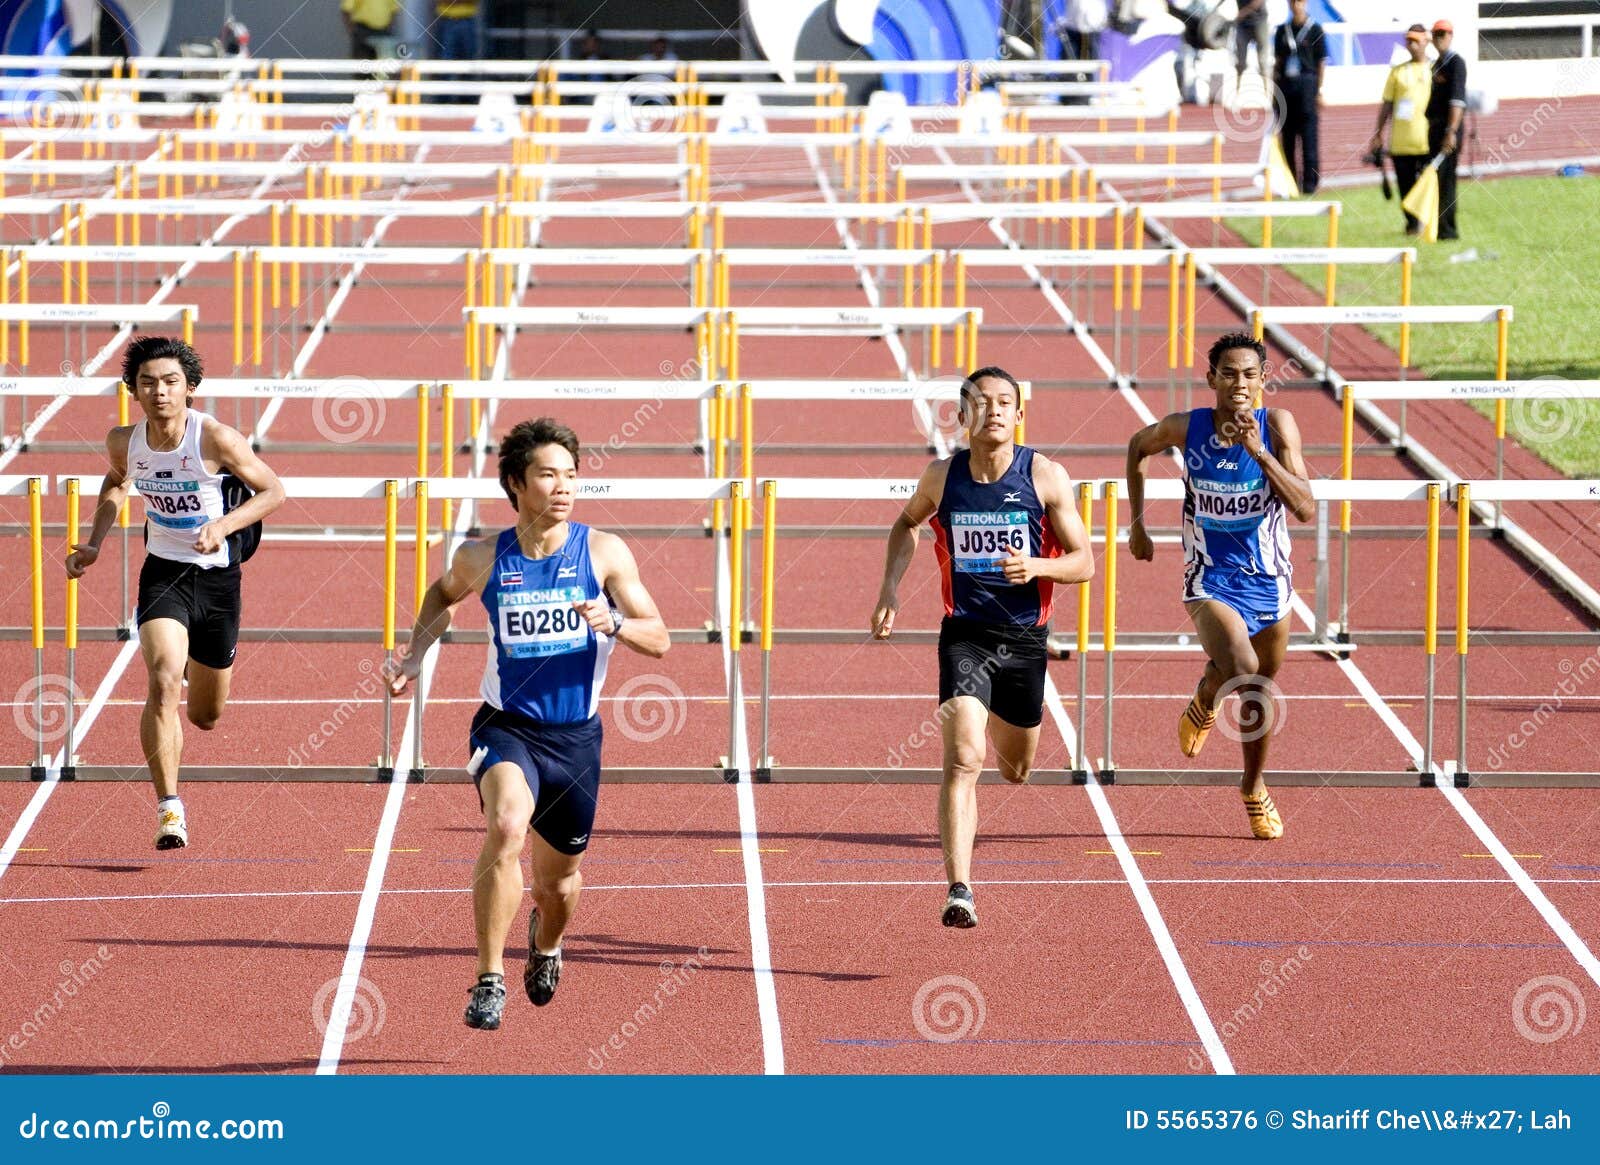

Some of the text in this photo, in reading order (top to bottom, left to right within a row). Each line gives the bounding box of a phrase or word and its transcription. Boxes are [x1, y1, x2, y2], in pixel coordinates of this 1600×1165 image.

[137, 480, 185, 491] PETRONAS
[1197, 480, 1248, 492] PETRONAS
[143, 493, 201, 514] T0843
[1198, 494, 1262, 516] M0492
[954, 513, 1010, 524] PETRONAS
[959, 529, 1024, 553] J0356
[502, 590, 567, 604] PETRONAS
[506, 608, 581, 636] E0280
